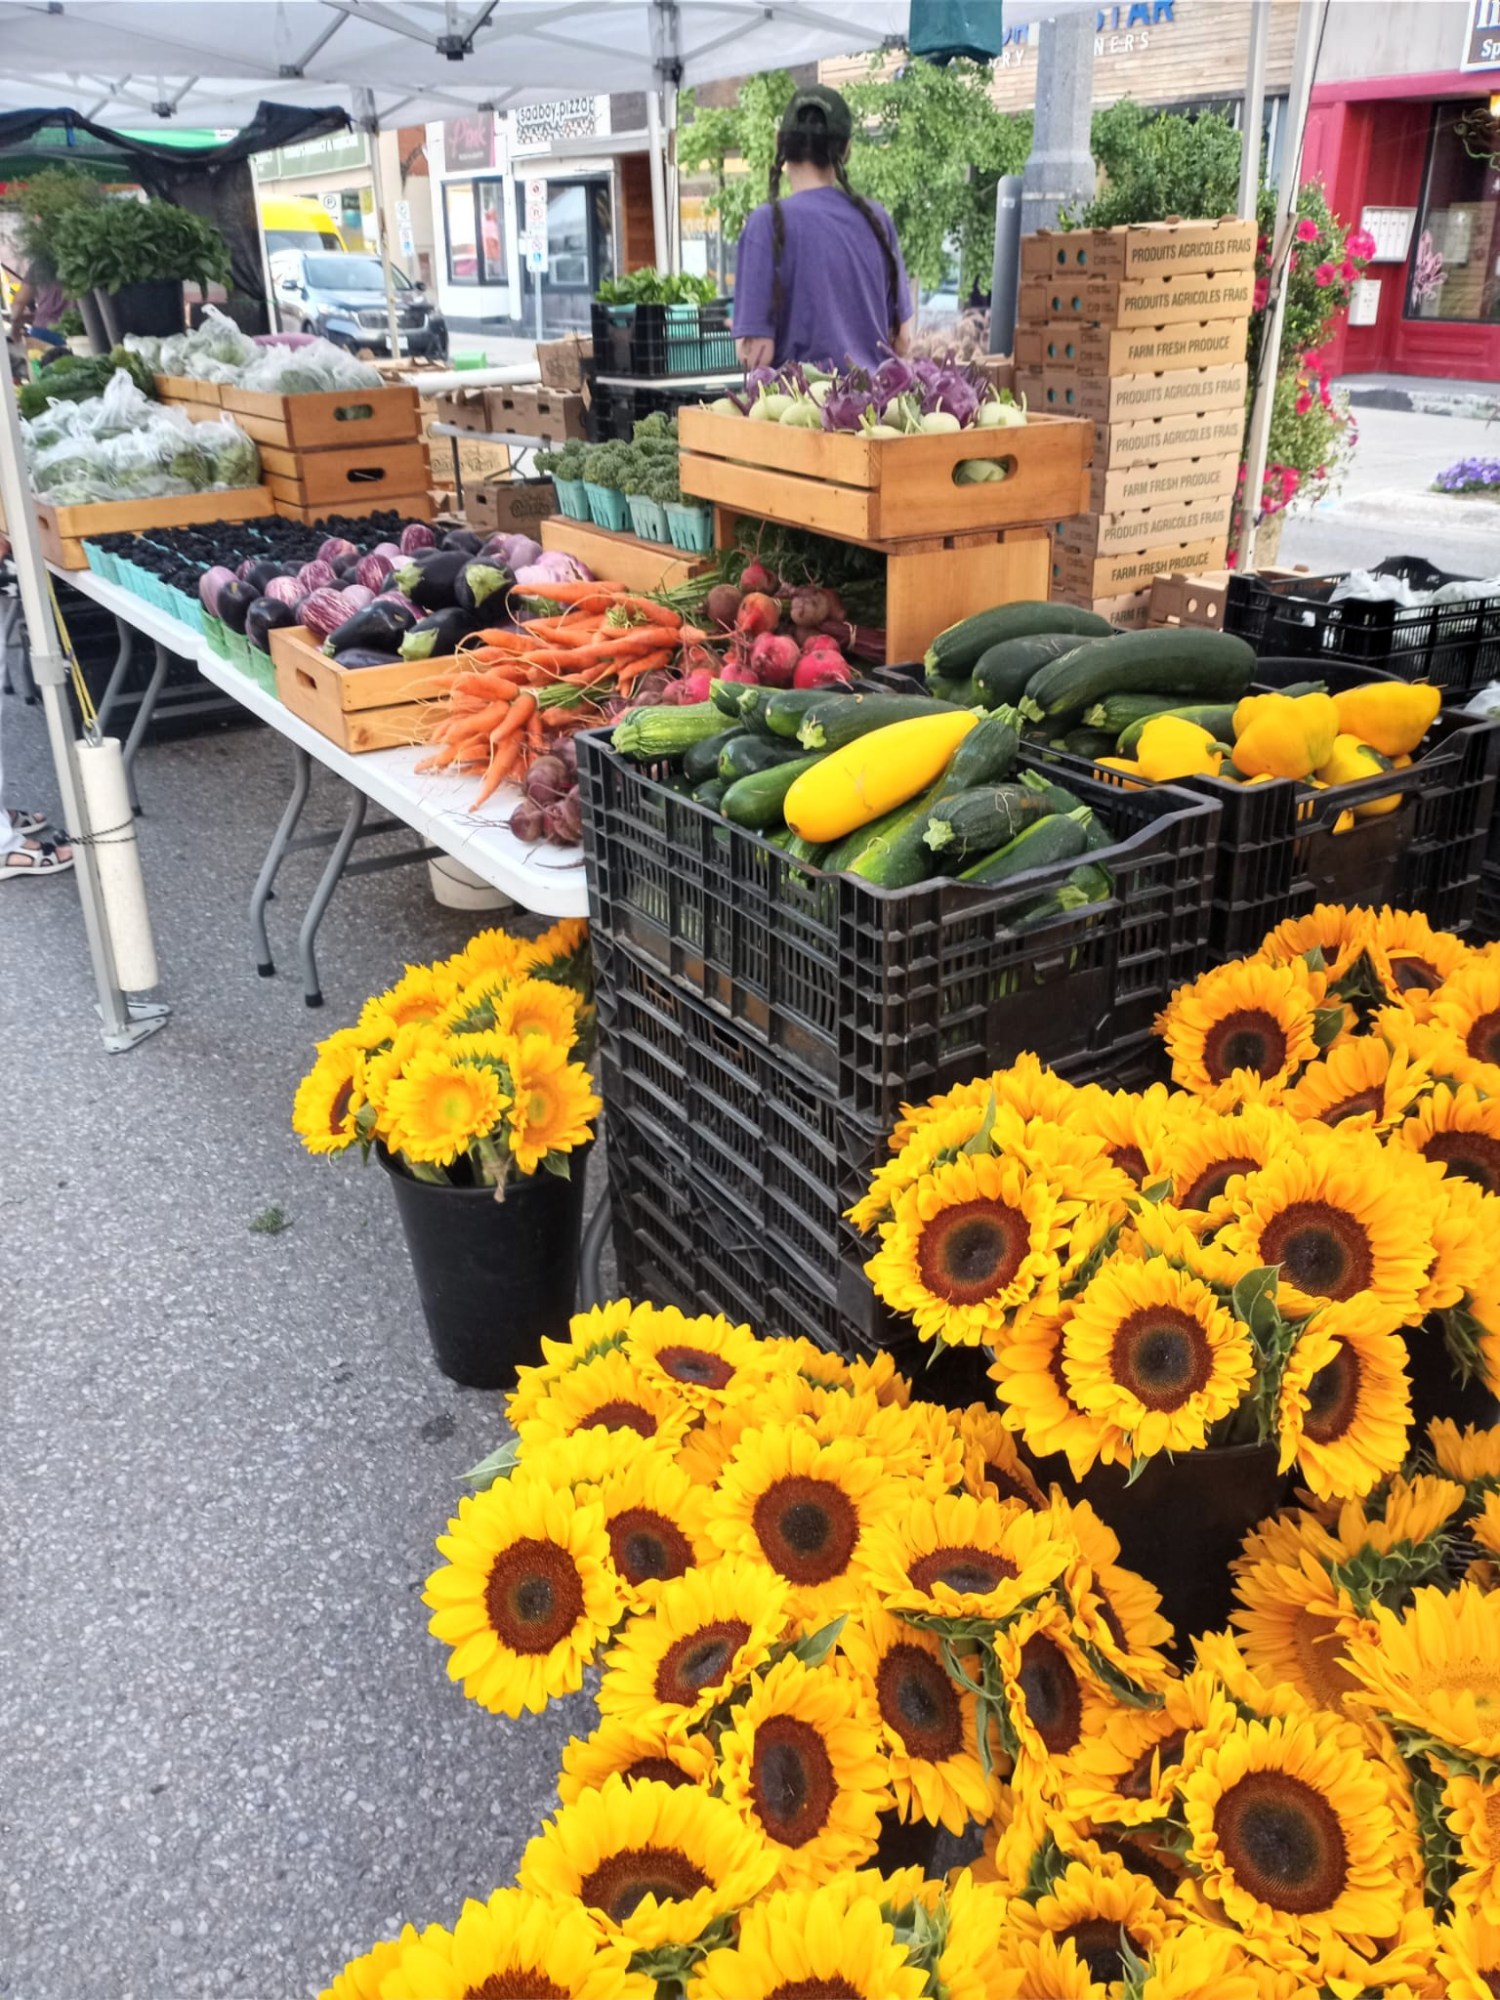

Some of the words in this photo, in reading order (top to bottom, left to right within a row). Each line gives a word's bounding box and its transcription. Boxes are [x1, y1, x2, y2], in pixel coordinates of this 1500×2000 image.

[1094, 32, 1149, 57] NERS
[1131, 244, 1176, 263] PRODUITS
[1178, 240, 1225, 258] AGRICOLES
[1227, 238, 1251, 253] FRAIS
[1124, 294, 1170, 312] PRODUITS
[1171, 290, 1221, 307] AGRICOLES
[1223, 287, 1248, 301] FRAIS
[1128, 343, 1155, 360] FARM
[1156, 340, 1186, 357] FRESH
[1188, 336, 1230, 353] PRODUCE
[1116, 388, 1162, 406] PRODUITS
[1164, 381, 1213, 400] AGRICOLES
[1215, 378, 1241, 393] FRAIS
[1116, 433, 1161, 452] PRODUITS
[1162, 427, 1212, 446] AGRICOLES
[1213, 423, 1239, 439] FRAIS
[1123, 480, 1148, 497] FARM
[1149, 477, 1178, 493] FRESH
[1180, 470, 1221, 488] PRODUCE
[1104, 522, 1149, 541] PRODUITS
[1150, 514, 1198, 533] AGRICOLES
[1200, 509, 1225, 524] FRAIS
[1111, 565, 1137, 582] FARM
[1138, 560, 1167, 577] FRESH
[1169, 552, 1209, 571] PRODUCE
[1110, 608, 1135, 624] FARM
